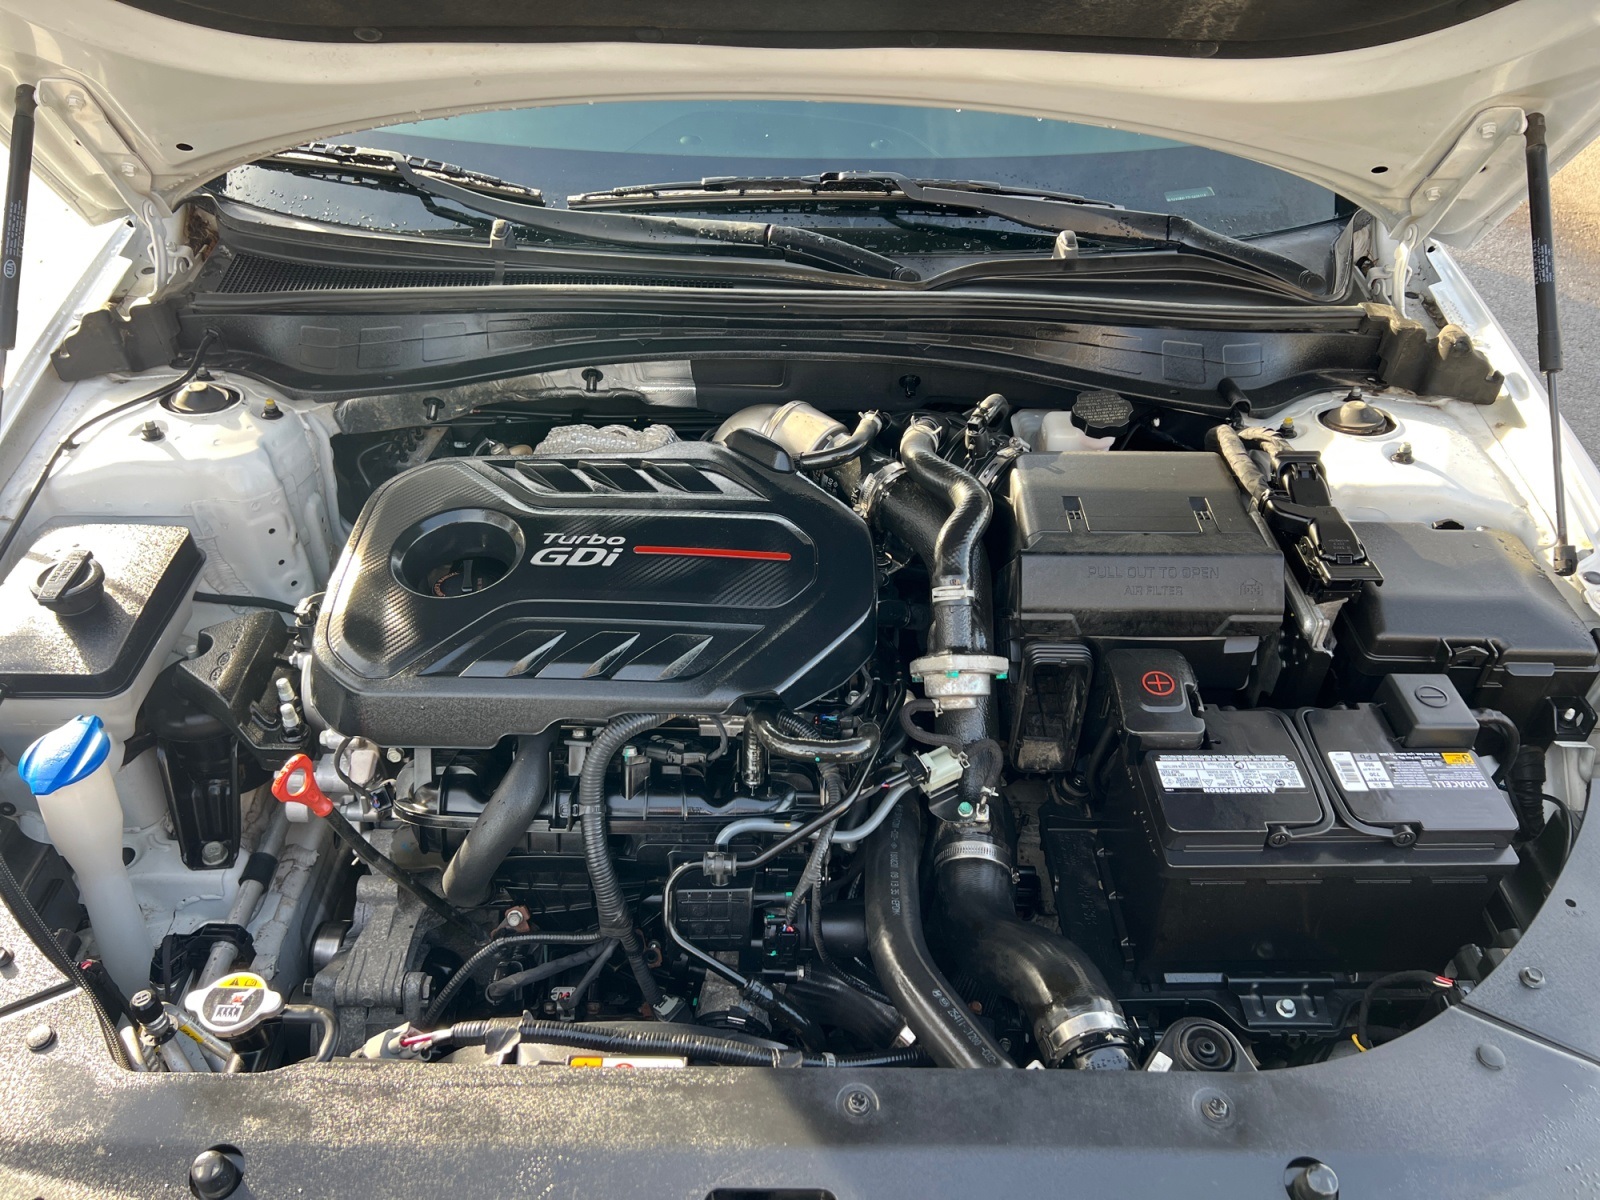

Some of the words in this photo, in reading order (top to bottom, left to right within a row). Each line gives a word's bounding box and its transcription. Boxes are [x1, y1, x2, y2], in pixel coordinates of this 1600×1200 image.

[543, 532, 627, 545] Turbo
[529, 547, 624, 566] GDi
[1087, 566, 1123, 579] PULL
[1127, 566, 1155, 579] OUT
[1159, 566, 1178, 579] TO
[1182, 566, 1220, 579] OPEN
[1124, 585, 1143, 596] AIR
[1146, 585, 1183, 596] FILTER
[1431, 780, 1489, 790] DURACELL
